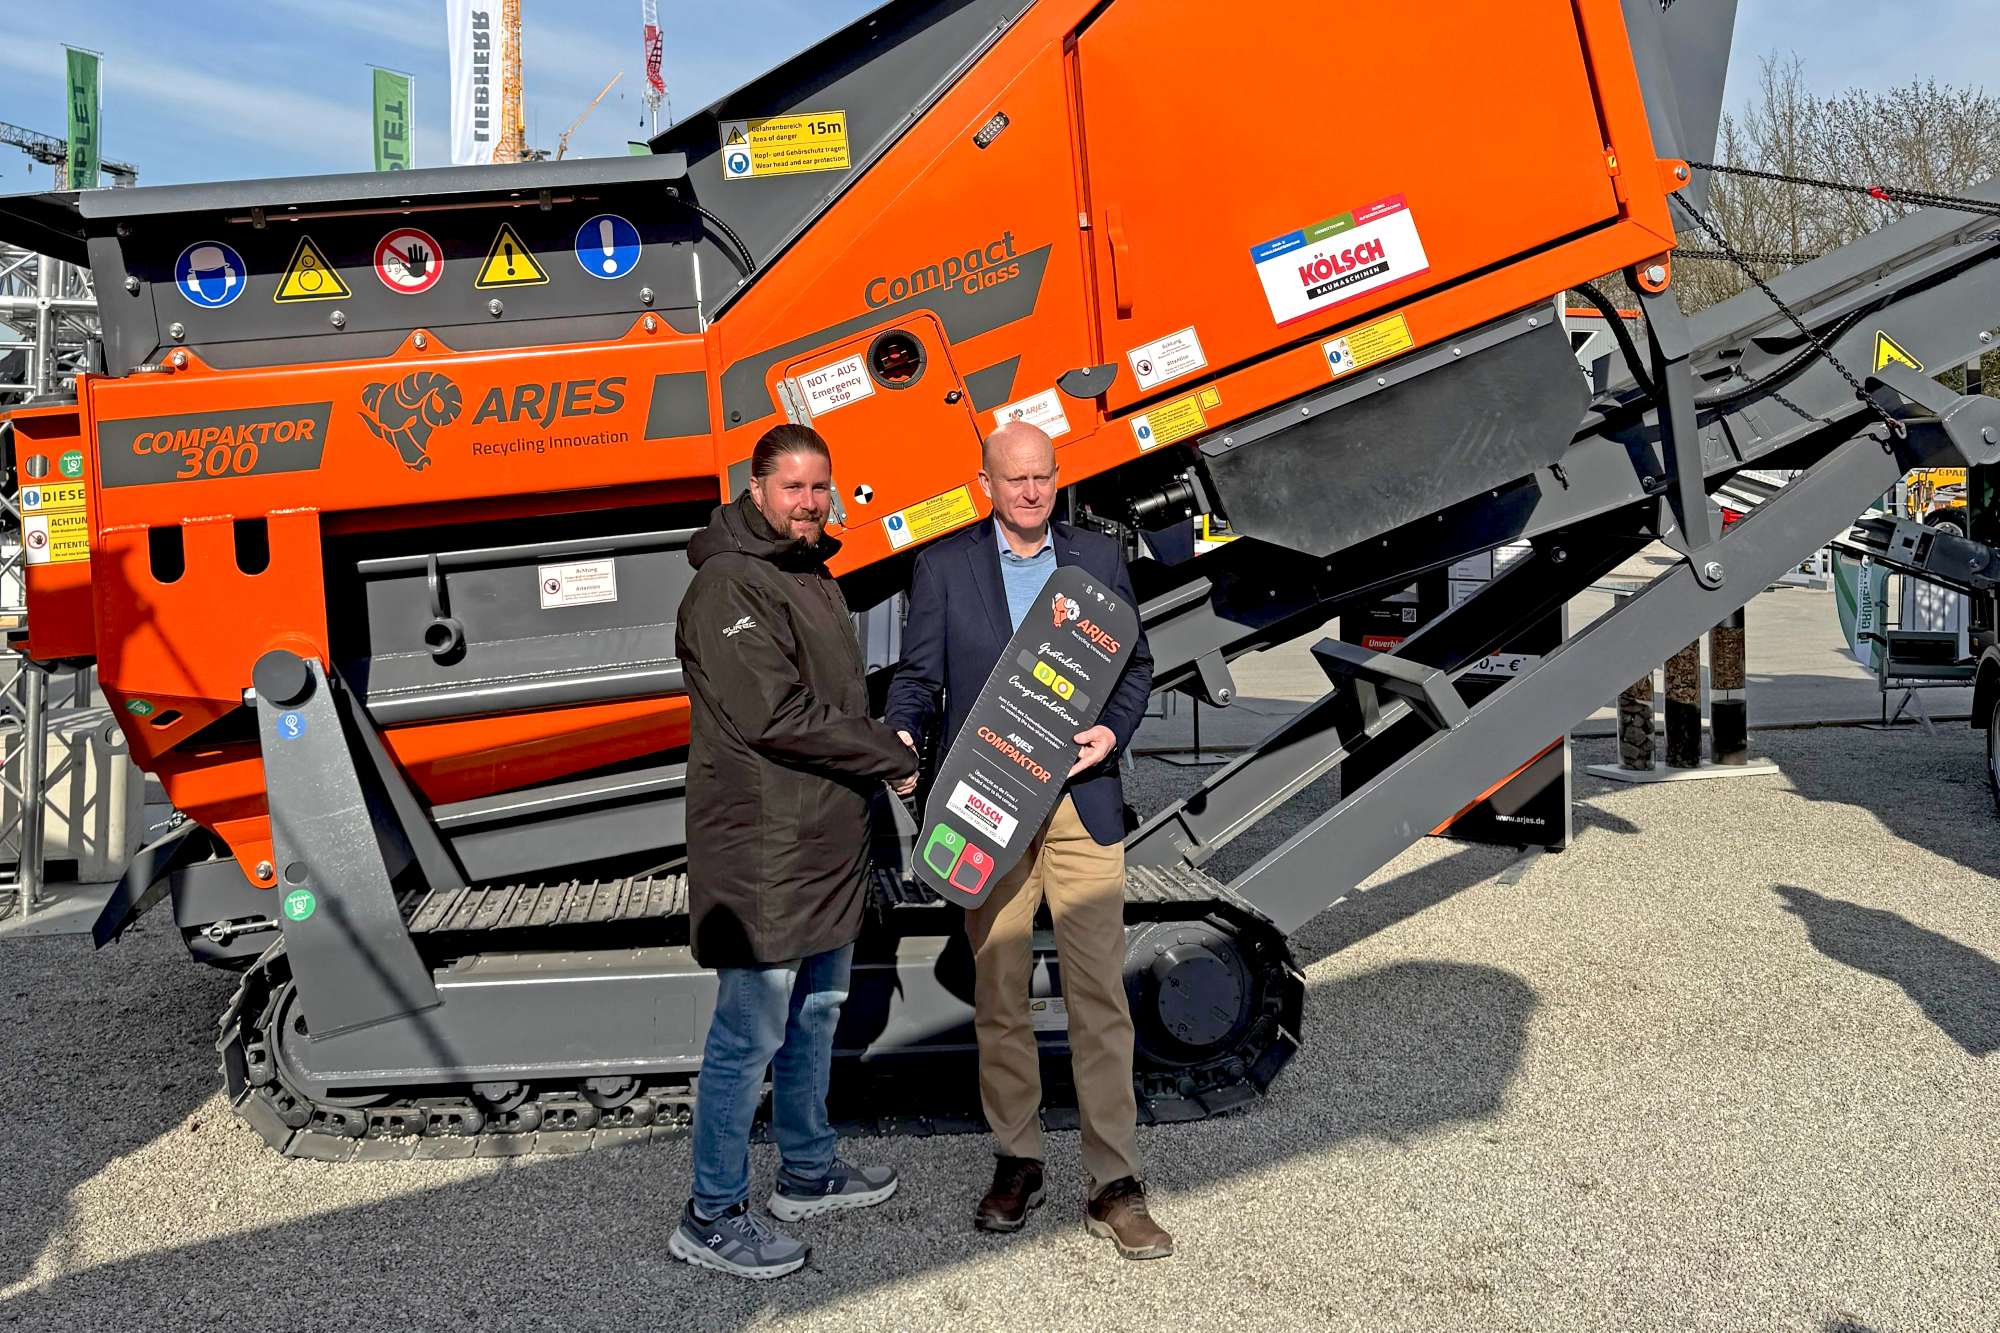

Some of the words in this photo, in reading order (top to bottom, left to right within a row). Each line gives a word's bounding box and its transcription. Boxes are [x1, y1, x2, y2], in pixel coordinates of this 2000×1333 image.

[776, 133, 797, 141] danger
[808, 121, 841, 135] 15m
[814, 155, 845, 164] protection
[865, 231, 1016, 309] Compact
[1298, 238, 1385, 287] KÖLSCH
[962, 262, 1020, 294] Class
[1317, 267, 1380, 294] BAUMASCHINEN
[807, 373, 827, 388] NOT
[837, 363, 857, 377] AUS
[812, 376, 861, 399] Emergency
[472, 376, 627, 429] ARJES
[830, 392, 851, 404] Stop
[132, 419, 315, 455] COMPAKTOR
[473, 438, 545, 456] Recycling
[550, 431, 628, 449] Innovation
[176, 443, 258, 479] 300
[42, 489, 85, 502] DIESE
[51, 516, 88, 527] ACHTUN
[1076, 619, 1121, 655] ARJES
[976, 725, 1052, 783] COMPAKTOR
[1007, 731, 1035, 754] ARJES
[1495, 815, 1545, 825] www.arjes.de
